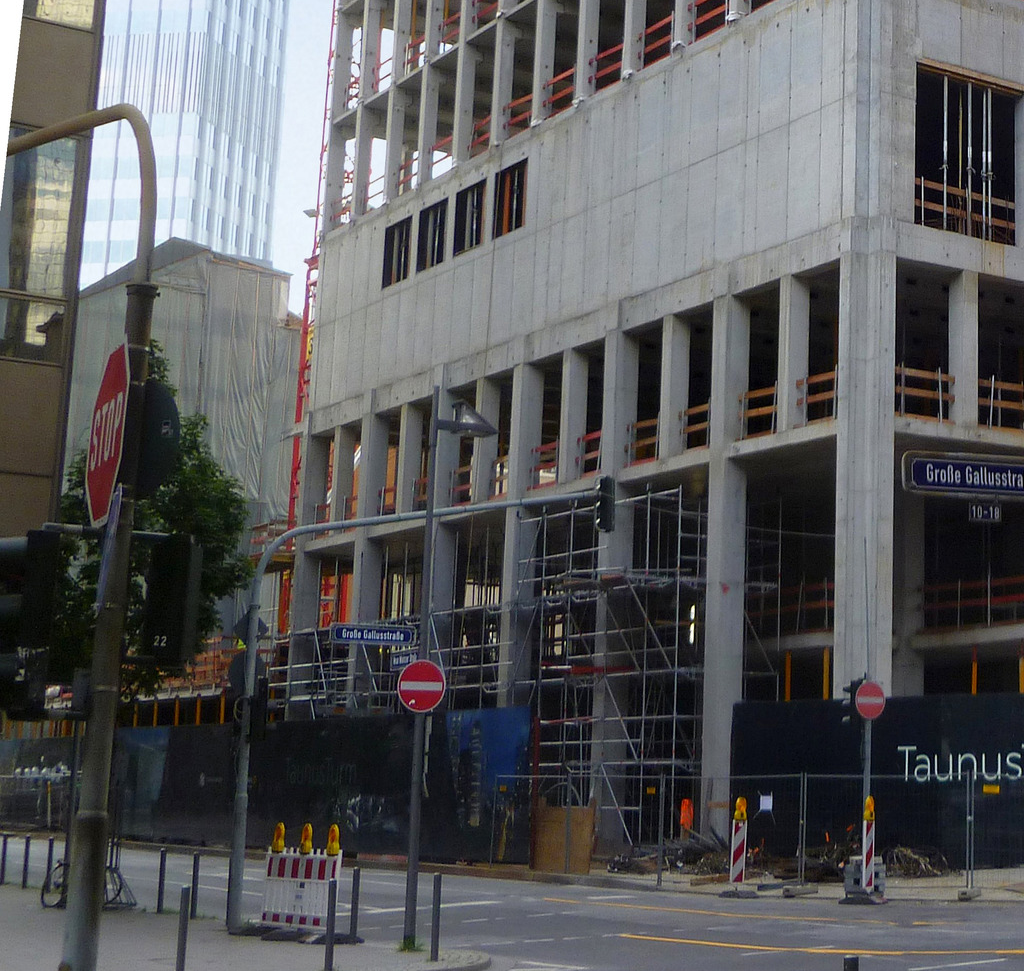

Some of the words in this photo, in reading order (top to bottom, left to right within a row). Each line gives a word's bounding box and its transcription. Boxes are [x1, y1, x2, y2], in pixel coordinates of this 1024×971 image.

[90, 391, 124, 471] STOP
[926, 463, 961, 484] Große
[971, 505, 1000, 520] 10-18
[153, 635, 167, 647] 22
[342, 628, 362, 638] Große
[363, 629, 404, 641] Gallusstraße
